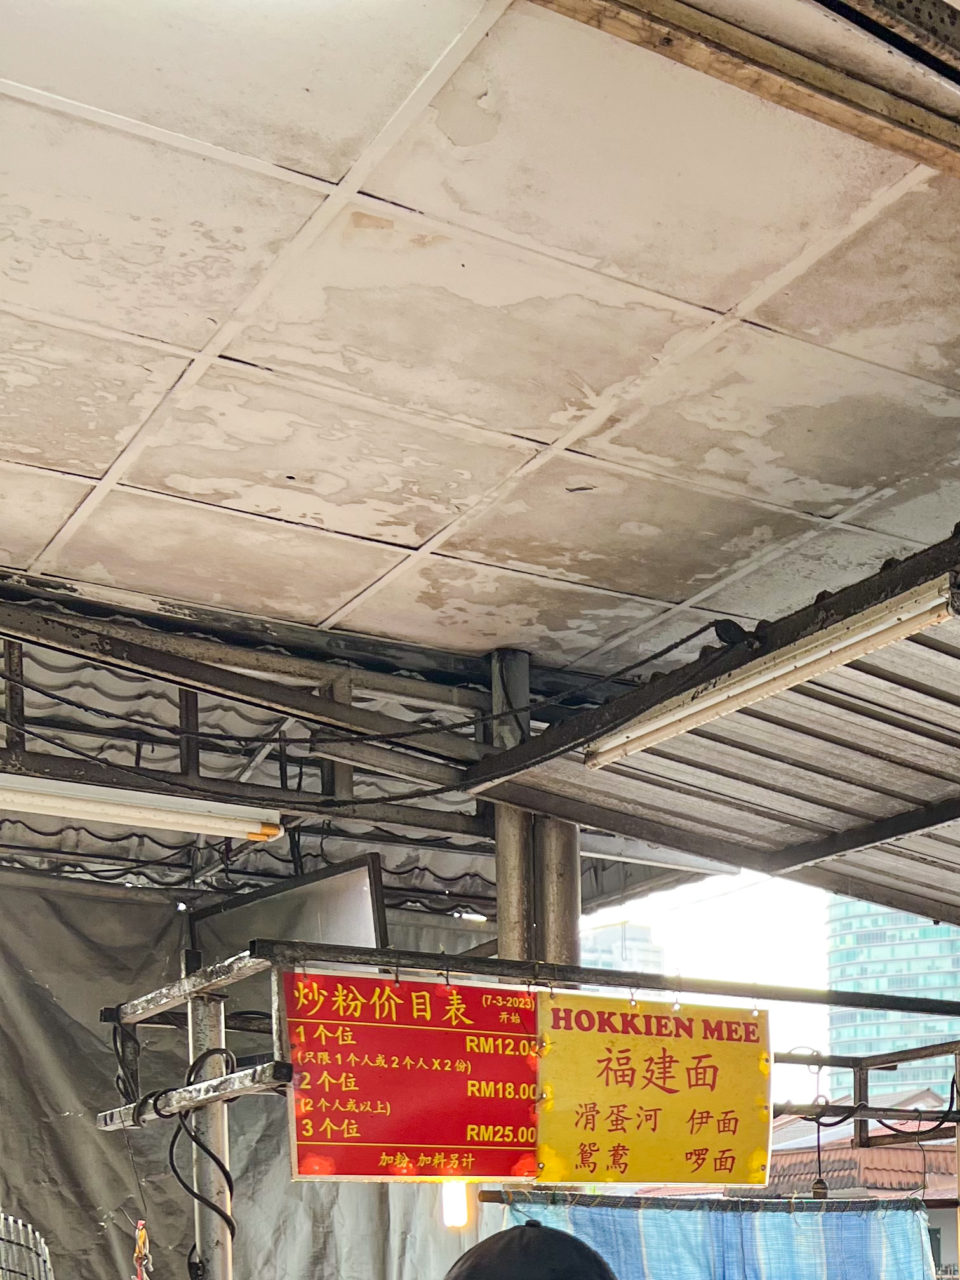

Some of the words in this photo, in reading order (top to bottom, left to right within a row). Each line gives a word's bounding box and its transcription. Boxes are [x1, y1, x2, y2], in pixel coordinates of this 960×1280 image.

[293, 981, 474, 1026] 炒粉价目表
[482, 994, 535, 1012] (7-3-2023)
[499, 1011, 521, 1024] 开始
[550, 1007, 694, 1039] HOKKIEN
[701, 1018, 760, 1043] MEE
[596, 1047, 719, 1094] 福建面
[467, 1080, 537, 1099] RM18.00
[574, 1102, 663, 1134] 滑蛋河
[686, 1108, 739, 1136] 伊面
[466, 1124, 537, 1143] RM25.00
